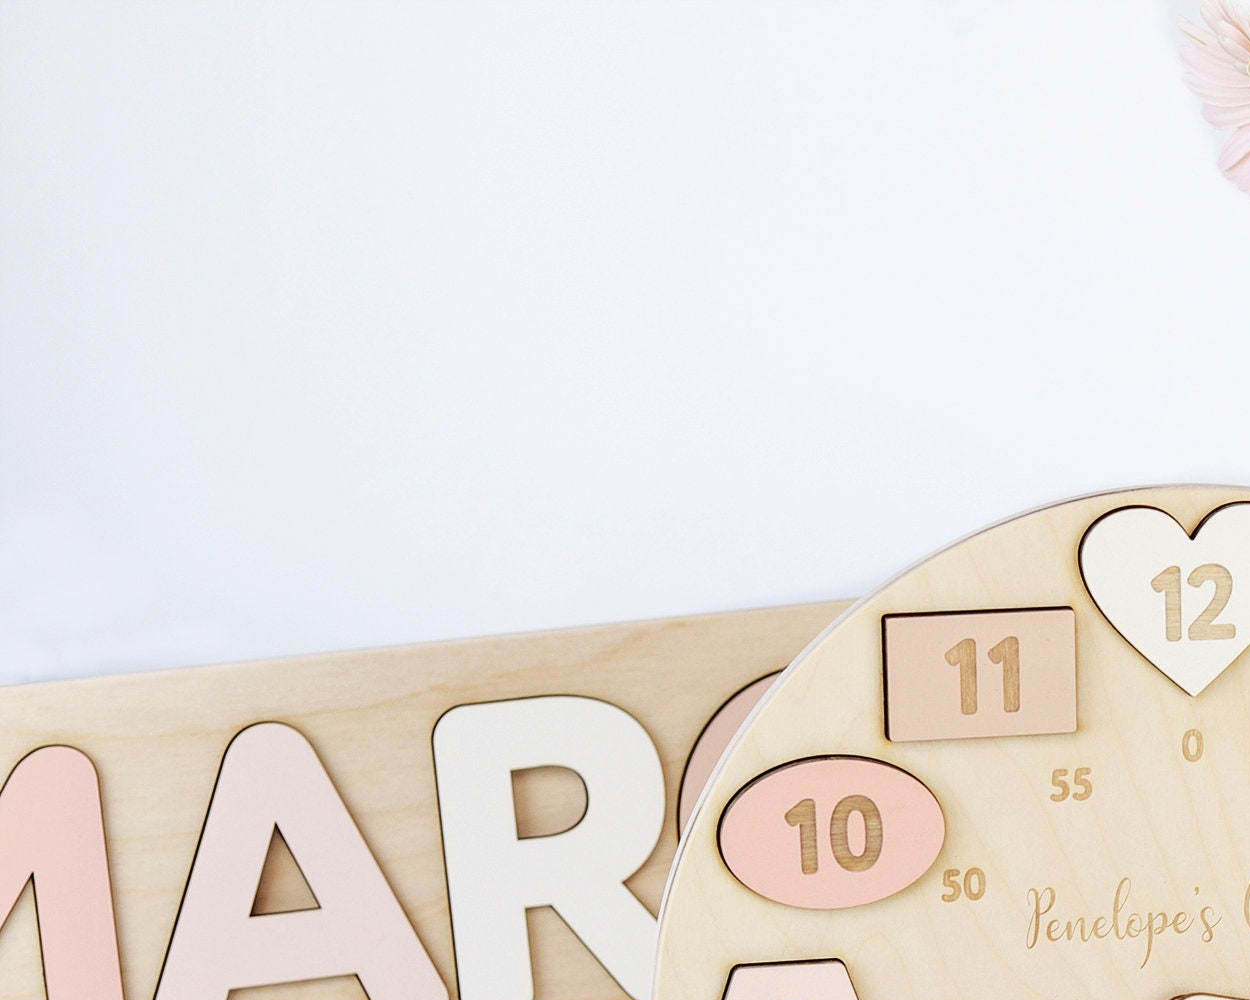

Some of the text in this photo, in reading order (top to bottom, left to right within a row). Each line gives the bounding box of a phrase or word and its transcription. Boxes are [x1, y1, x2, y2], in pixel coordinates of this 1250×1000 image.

[1151, 563, 1236, 642] 12
[945, 636, 1020, 715] 11
[1050, 767, 1092, 802] 55
[1182, 729, 1203, 762] 0
[784, 795, 883, 874] 10
[941, 867, 986, 902] 50
[1026, 878, 1222, 969] Penelope's
